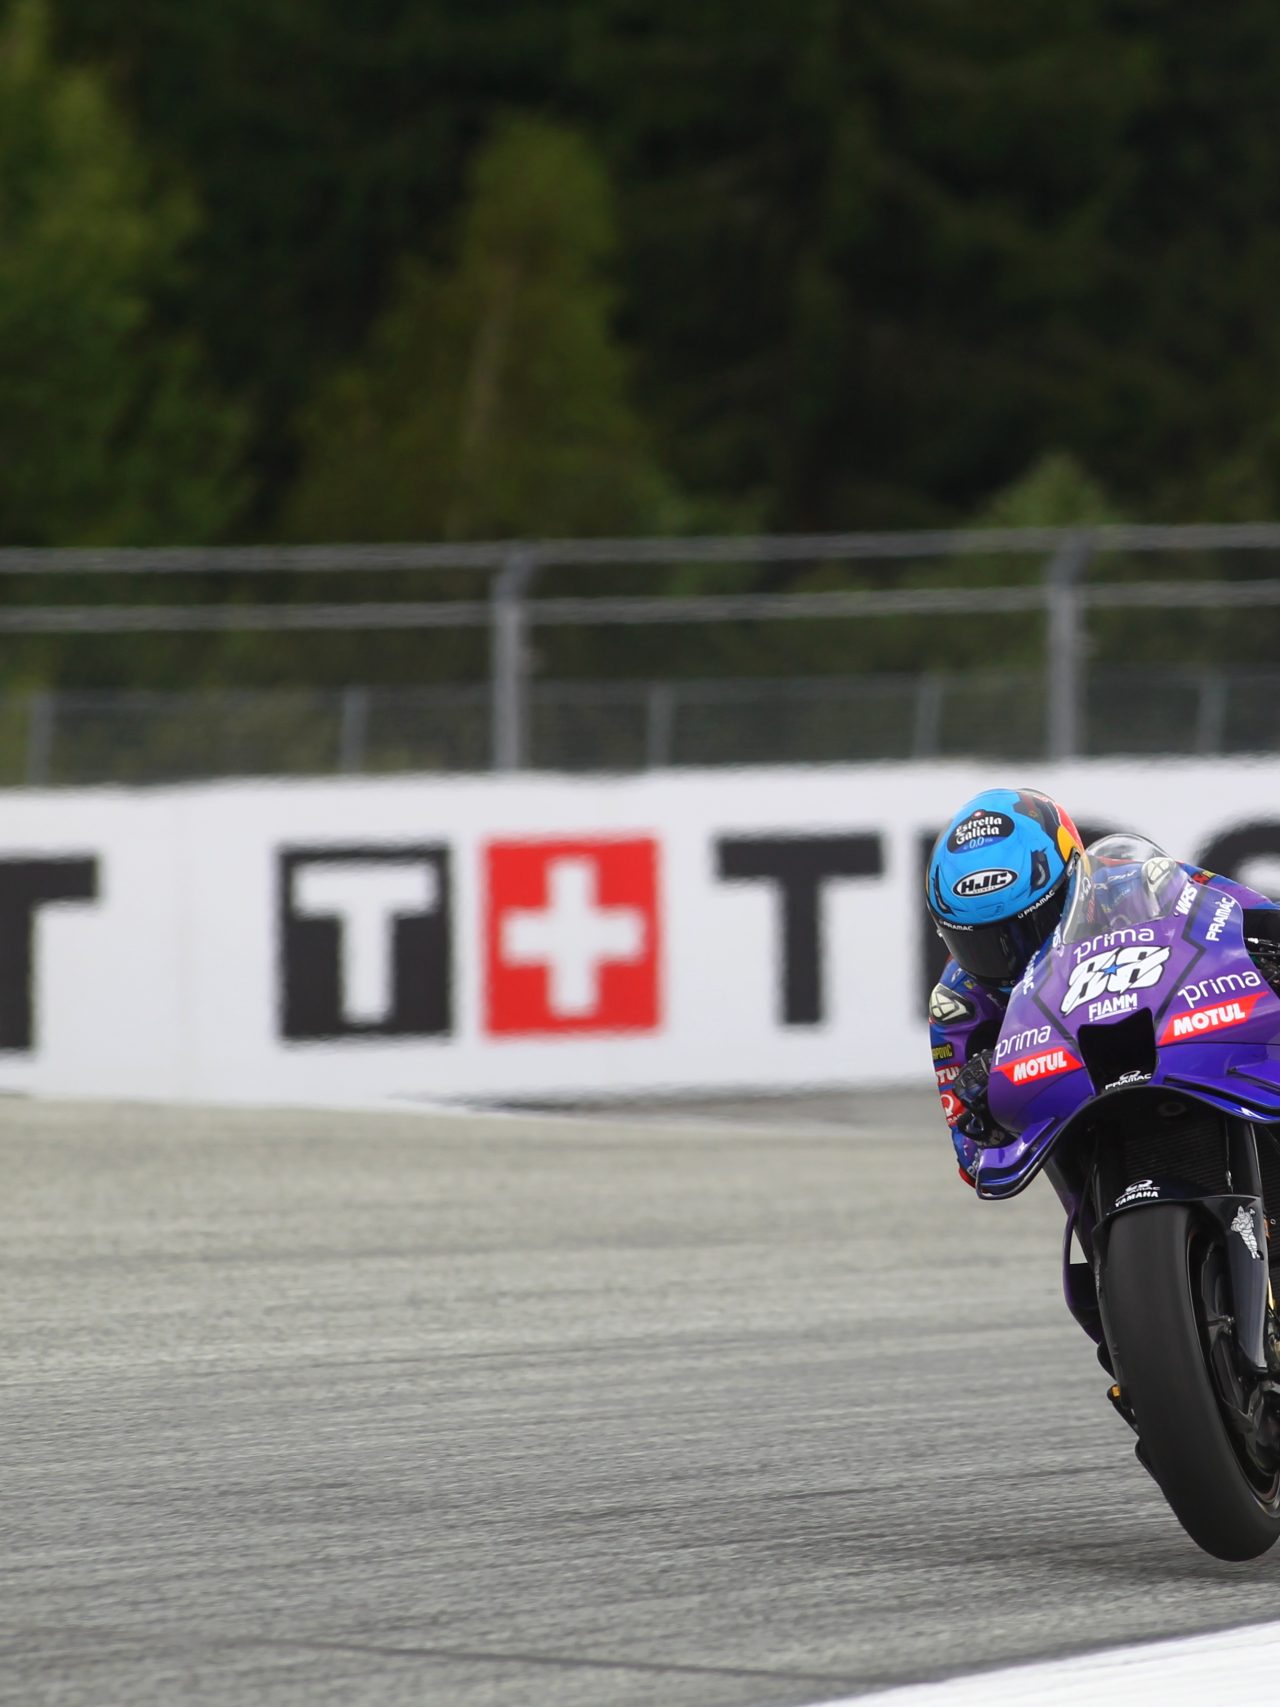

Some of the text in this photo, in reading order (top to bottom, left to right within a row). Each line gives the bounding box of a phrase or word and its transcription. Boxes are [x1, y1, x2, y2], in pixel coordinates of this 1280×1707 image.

[955, 816, 1002, 836] Estrella
[955, 825, 1000, 845] Galicia
[961, 872, 1008, 894] HJC
[1023, 889, 1055, 916] PRAMAC
[1073, 926, 1154, 963] prima
[1061, 945, 1170, 1016] 88
[1177, 970, 1261, 1008] prima
[1089, 993, 1138, 1019] FIAMM
[1173, 1002, 1246, 1037] MOTUL
[995, 1025, 1051, 1066] prima
[1013, 1051, 1067, 1083] MOTUL
[1115, 1191, 1159, 1208] YAMAHA
